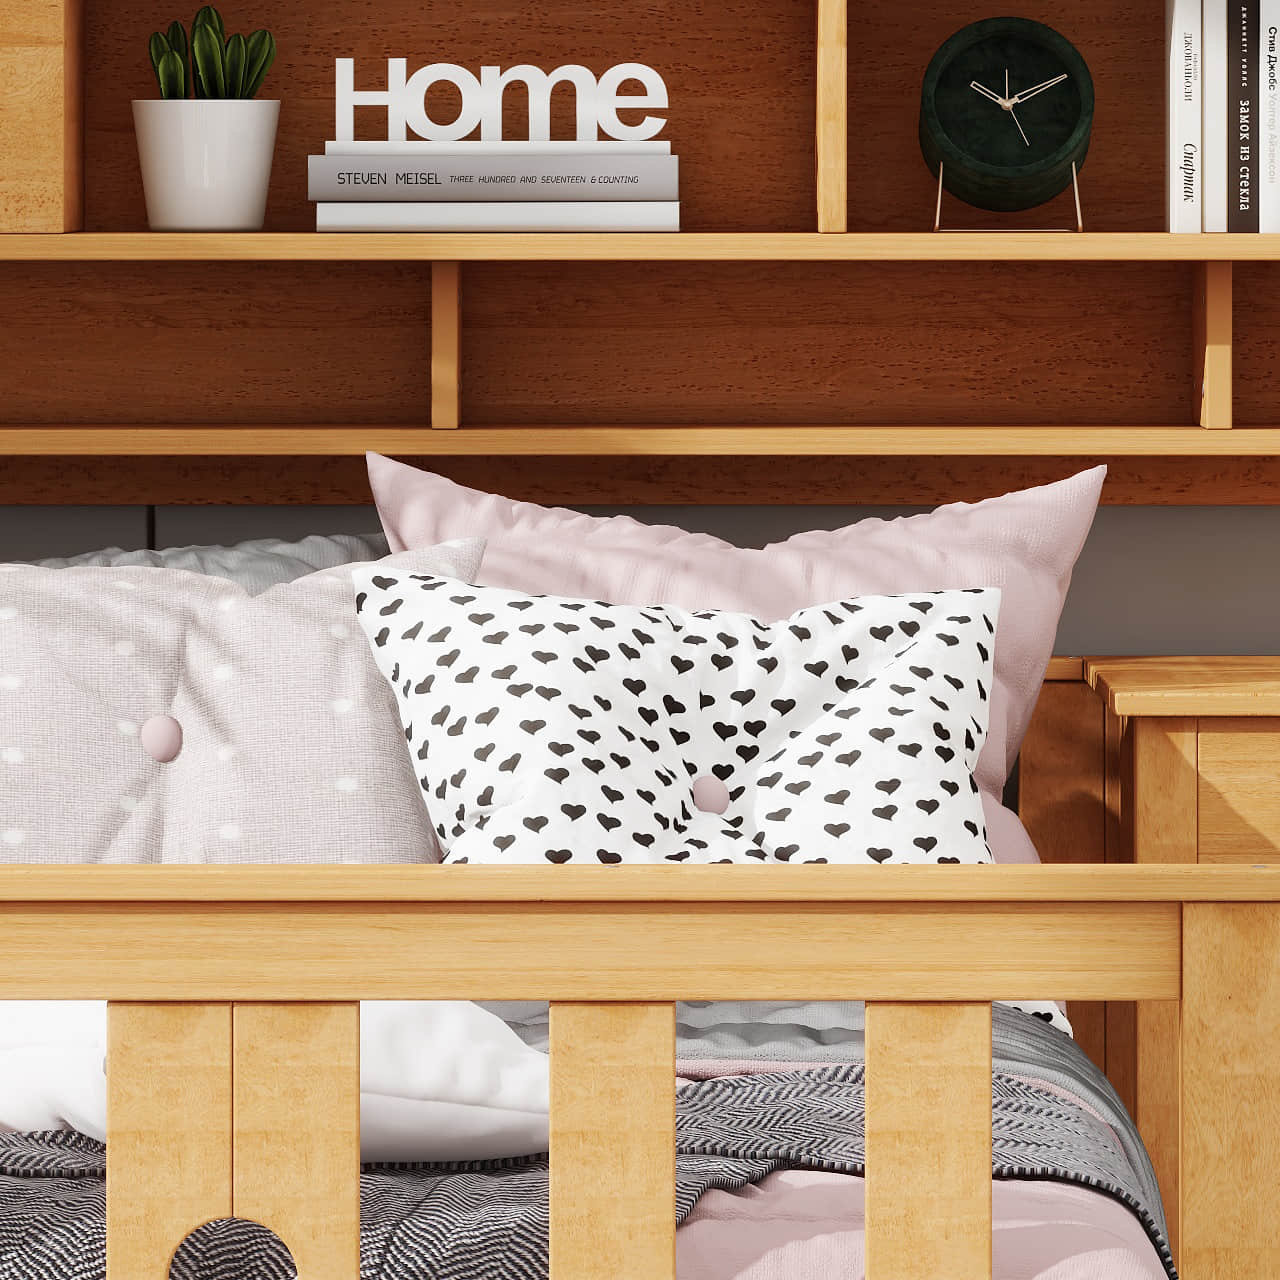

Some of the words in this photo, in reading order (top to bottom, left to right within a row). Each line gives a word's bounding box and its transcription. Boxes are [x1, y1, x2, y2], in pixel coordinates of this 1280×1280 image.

[1269, 27, 1278, 52] Стив
[1267, 55, 1278, 91] Джобс
[335, 58, 669, 141] Home
[1239, 100, 1251, 140] замок
[1239, 146, 1251, 161] из
[337, 172, 387, 185] STEVEN
[395, 172, 442, 185] MEISEL
[449, 175, 474, 183] THREE
[478, 175, 516, 184] HUNDRED
[519, 175, 537, 184] AND
[540, 175, 586, 184] SEVENTEEN
[598, 175, 639, 184] COUNTING
[1180, 143, 1198, 203] Спартак
[1239, 166, 1251, 210] стекла
